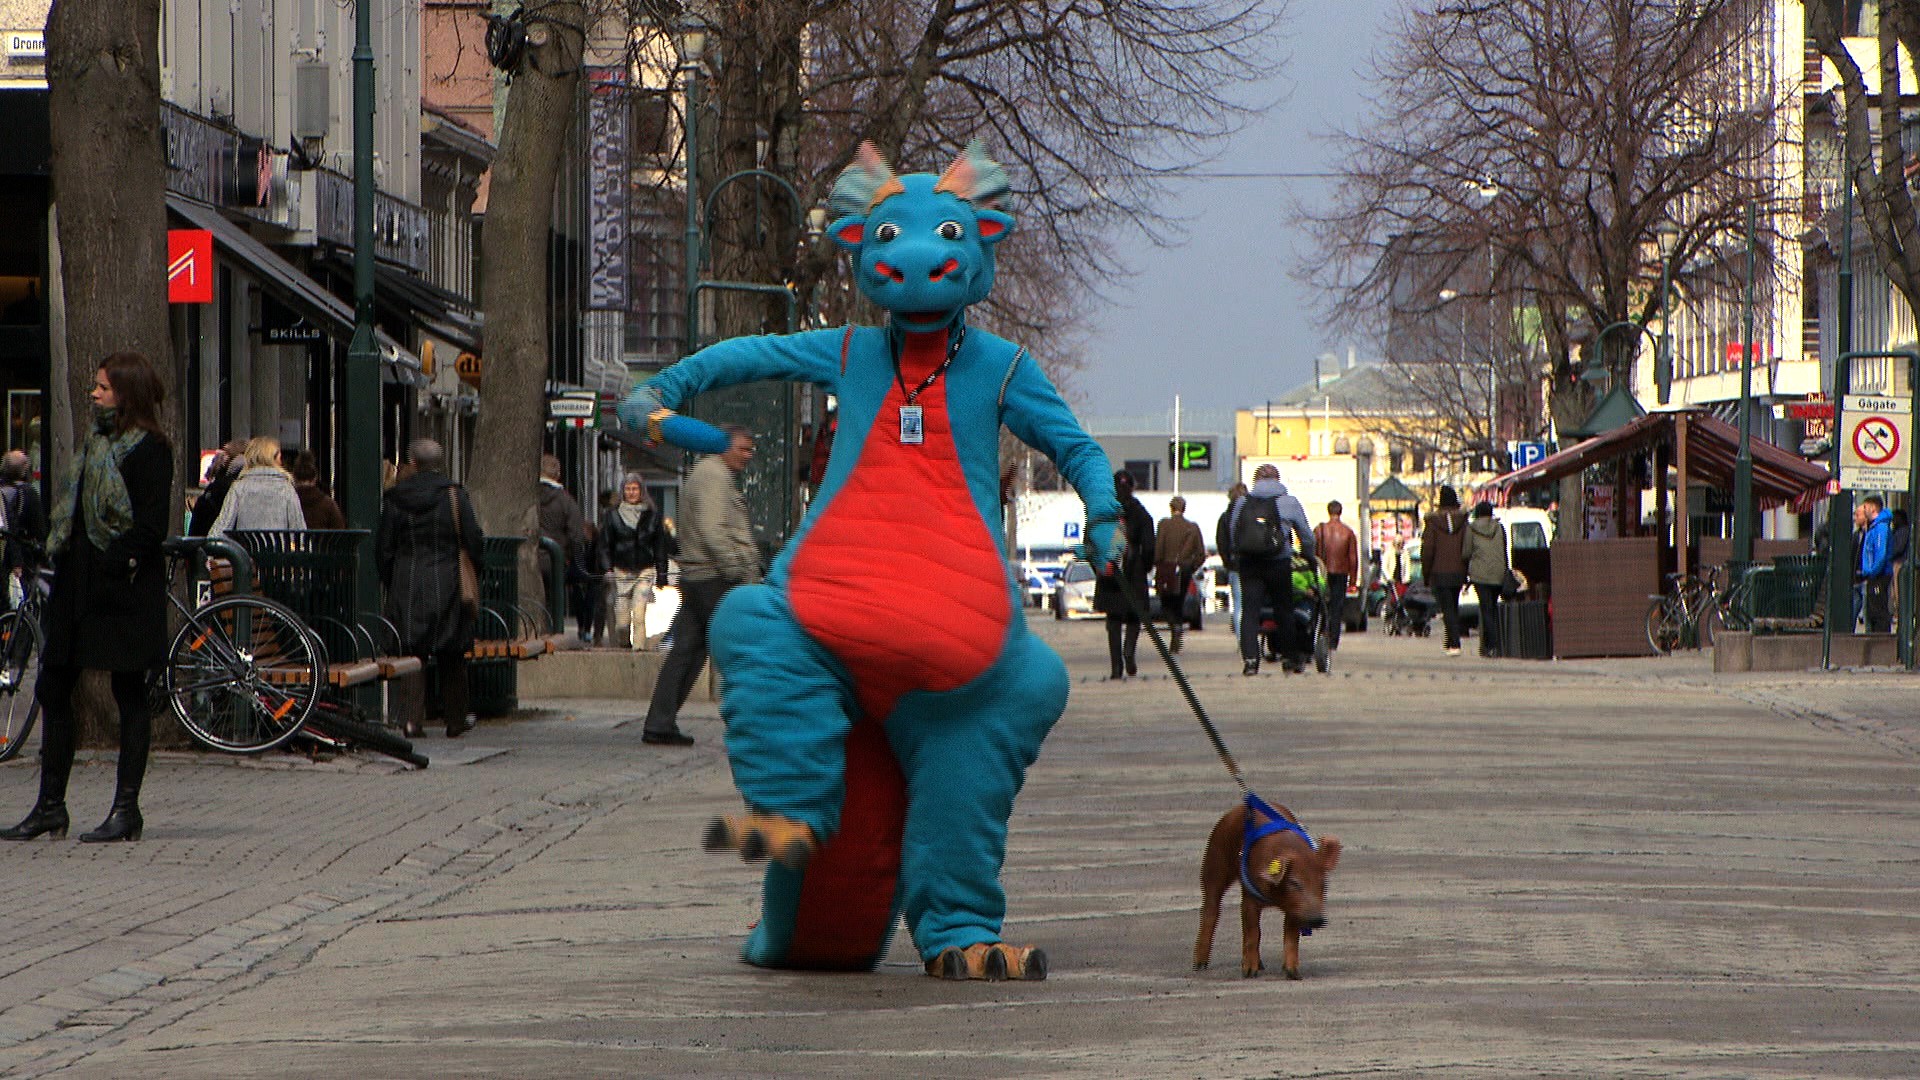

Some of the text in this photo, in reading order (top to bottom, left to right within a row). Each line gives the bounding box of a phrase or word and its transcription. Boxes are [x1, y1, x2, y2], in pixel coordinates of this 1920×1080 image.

[270, 328, 320, 338] SKILLS
[1858, 398, 1897, 411] Gågate
[1526, 446, 1540, 467] P
